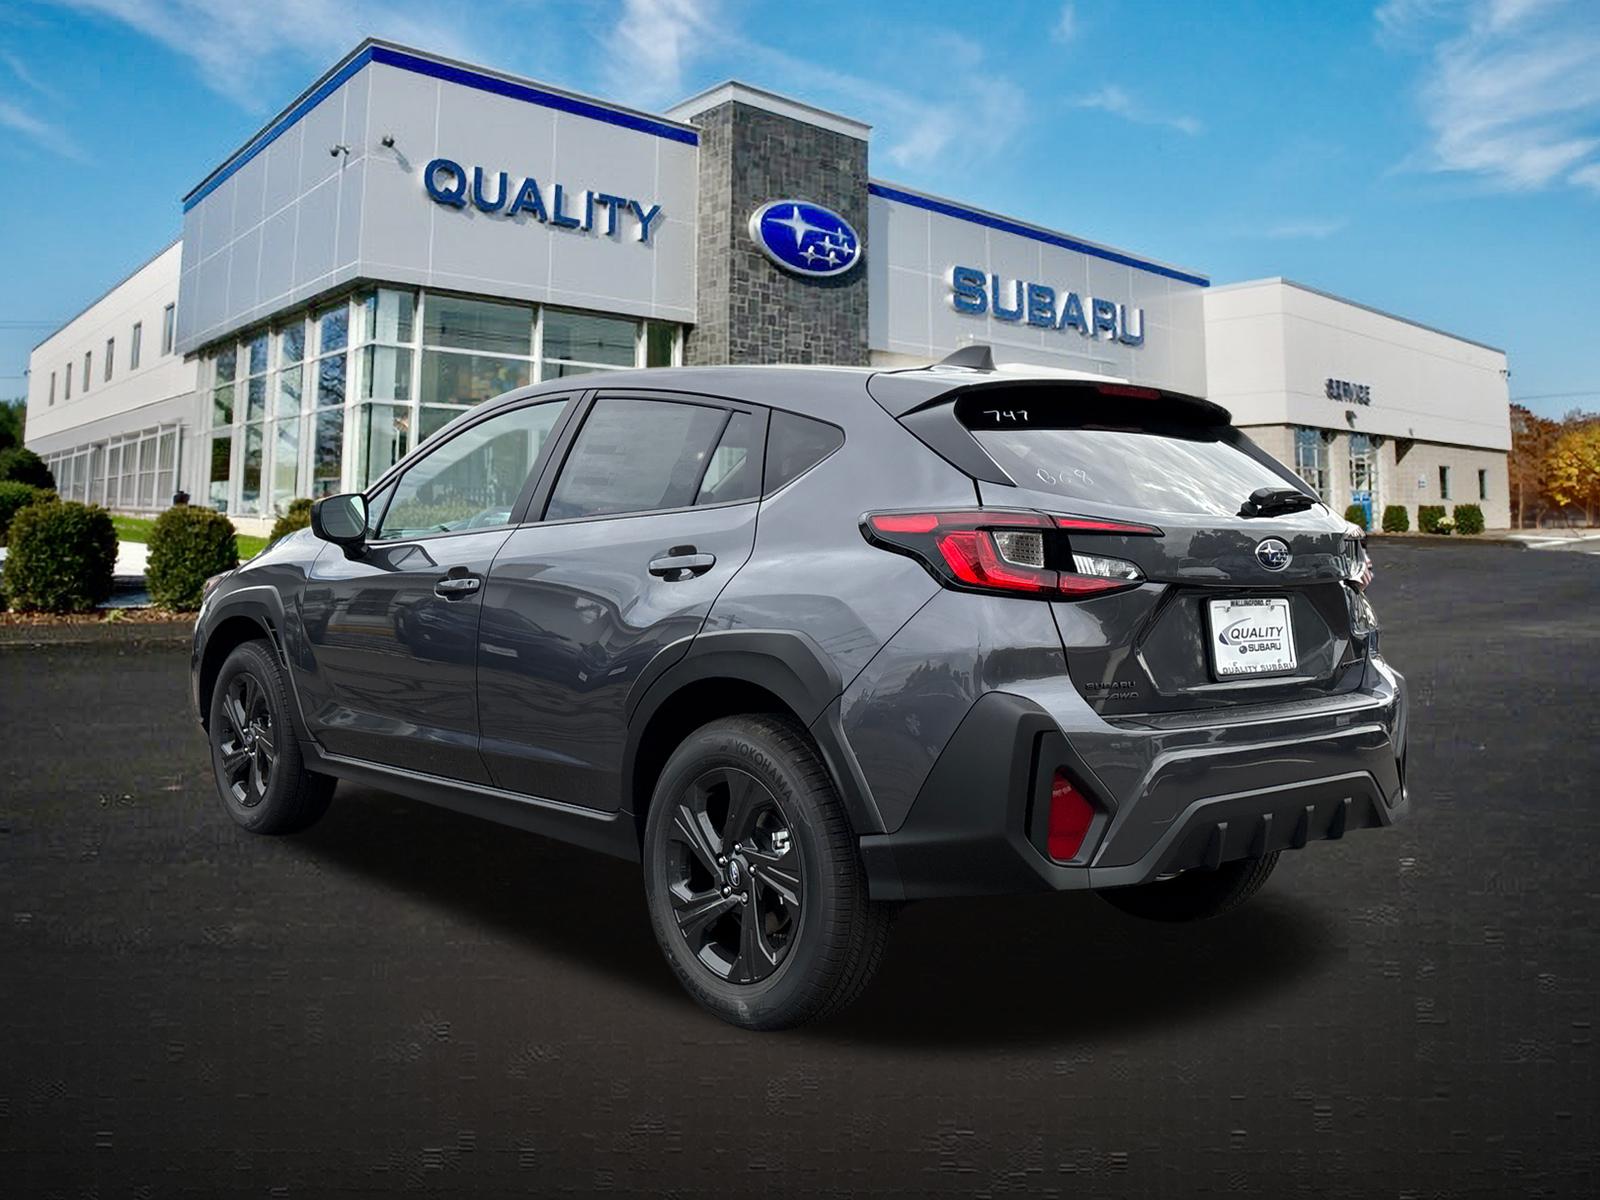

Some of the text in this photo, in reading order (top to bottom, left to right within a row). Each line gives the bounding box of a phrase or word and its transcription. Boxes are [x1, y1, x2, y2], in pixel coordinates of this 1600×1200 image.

[424, 158, 662, 244] QUALITY
[948, 265, 1145, 347] SUBARU
[1325, 378, 1371, 406] SERVICE
[983, 409, 1028, 421] 747
[1230, 626, 1283, 640] QUALITY
[1247, 642, 1281, 653] SUBARU
[1222, 663, 1296, 674] QUALITY SUBARU
[1085, 681, 1136, 690] SUBARU
[735, 740, 793, 802] YOKOHAMA
